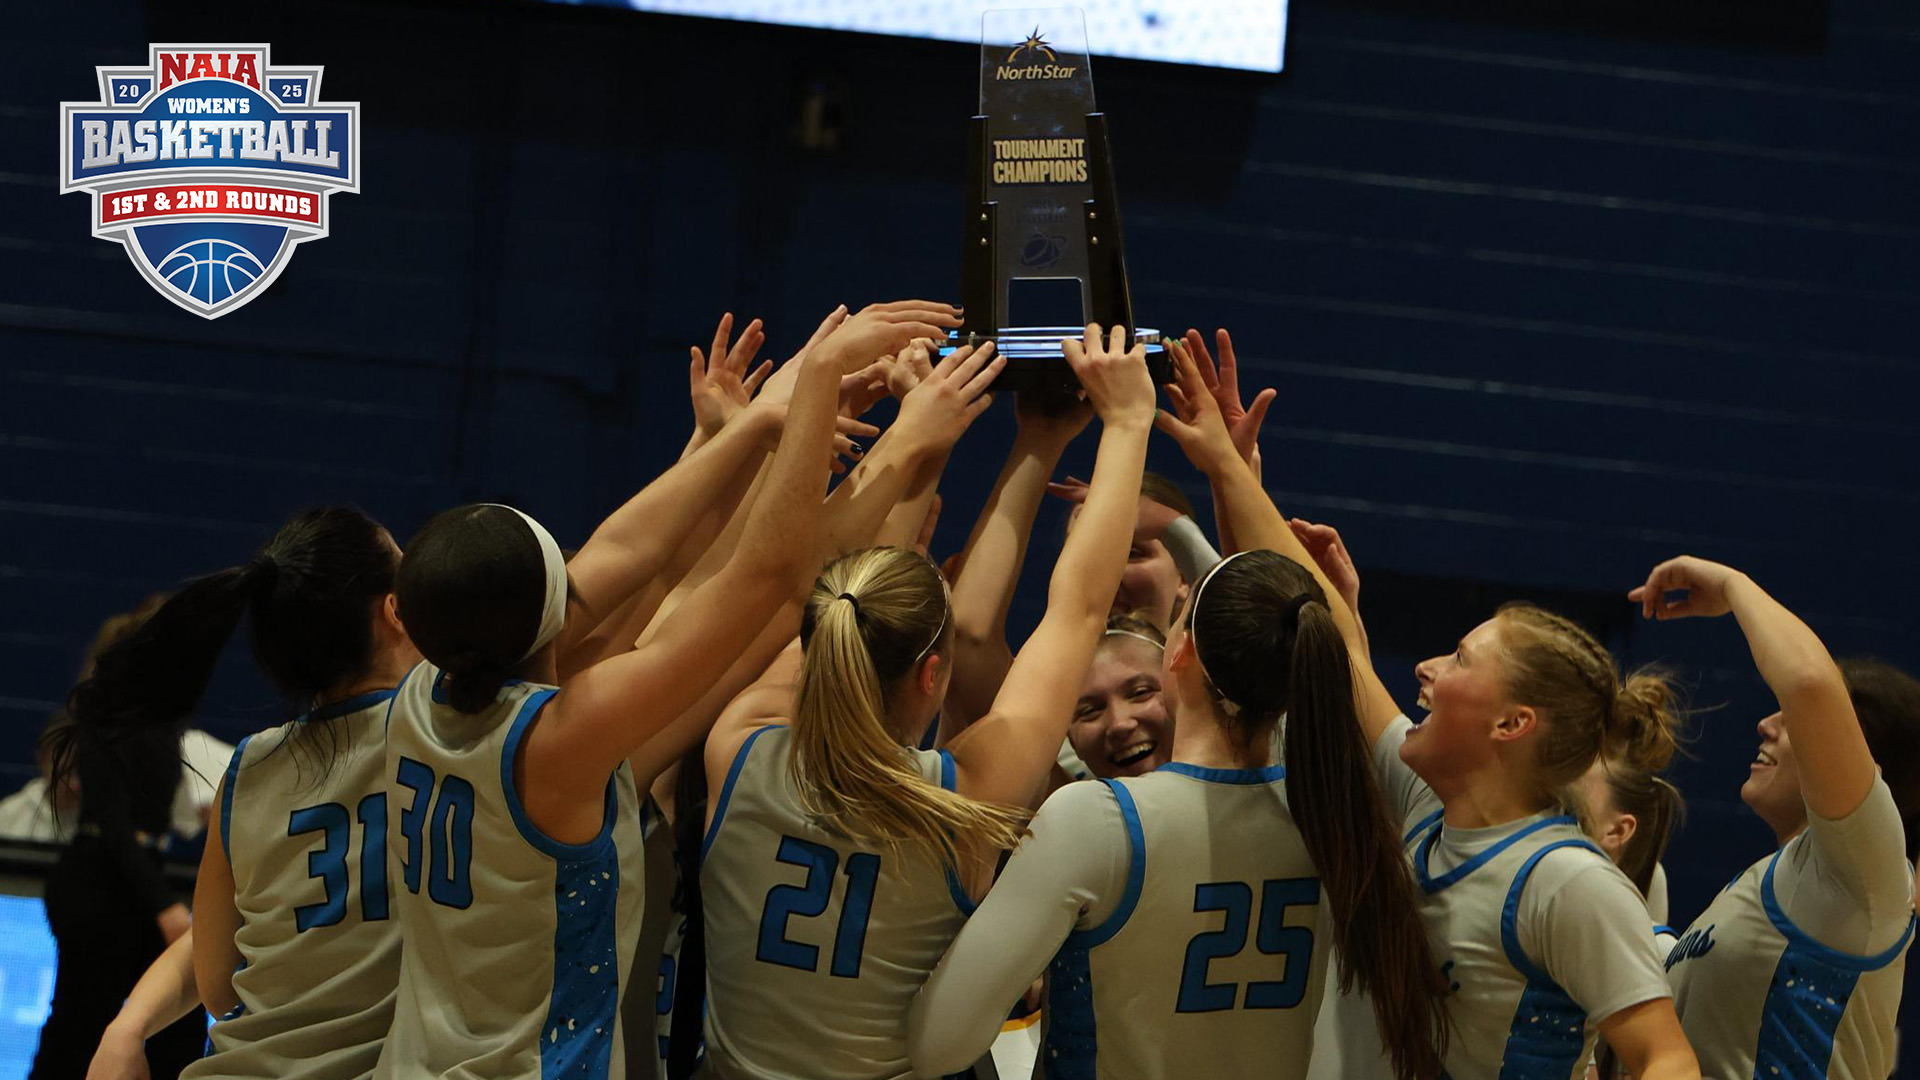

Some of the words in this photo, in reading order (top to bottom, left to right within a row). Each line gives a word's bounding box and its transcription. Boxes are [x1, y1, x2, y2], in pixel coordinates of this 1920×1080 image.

[993, 139, 1085, 160] TOURNAMENT
[993, 160, 1088, 184] CHAMPIONS
[288, 792, 389, 933] 31
[396, 756, 475, 909] 30
[756, 834, 881, 978] 21
[1175, 877, 1321, 1013] 25
